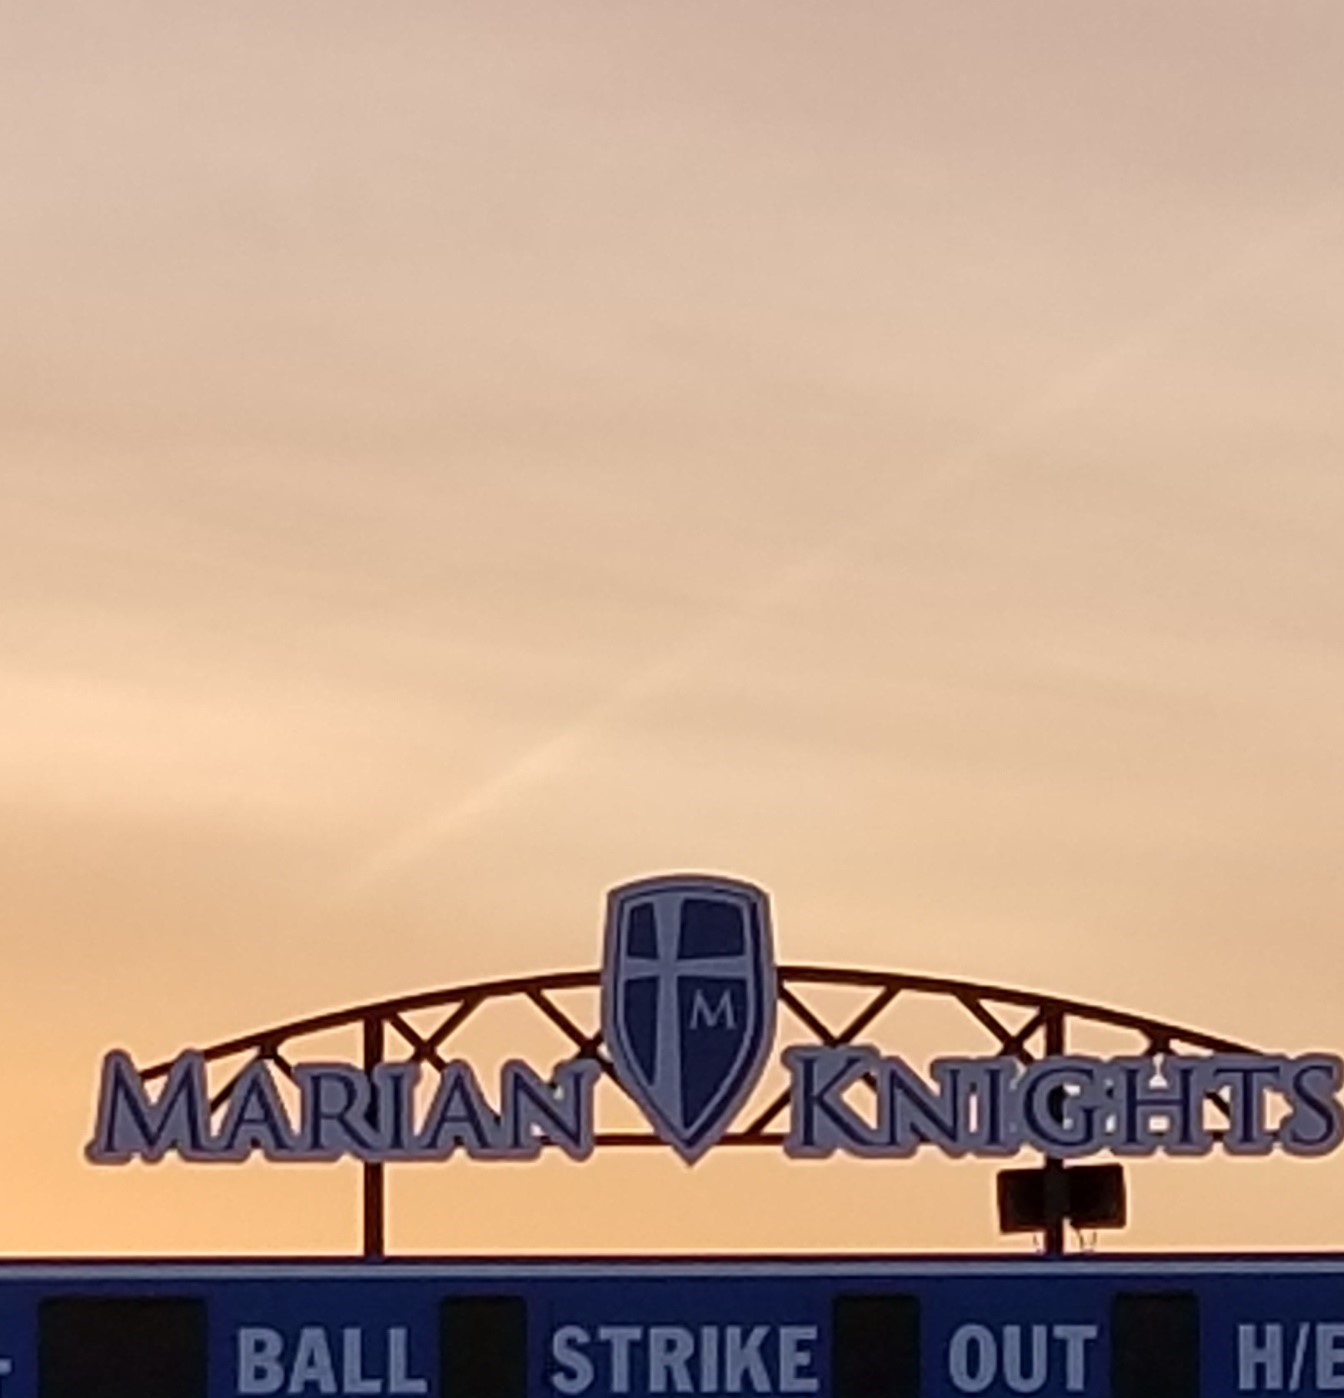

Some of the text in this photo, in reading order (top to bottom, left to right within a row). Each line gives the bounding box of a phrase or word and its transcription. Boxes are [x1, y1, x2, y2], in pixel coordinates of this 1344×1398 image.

[688, 989, 736, 1030] M
[96, 1052, 1340, 1157] MARIAN KNIGHTS
[238, 1328, 428, 1394] BALL
[552, 1325, 819, 1394] STRIKE
[949, 1324, 1098, 1392] OUT
